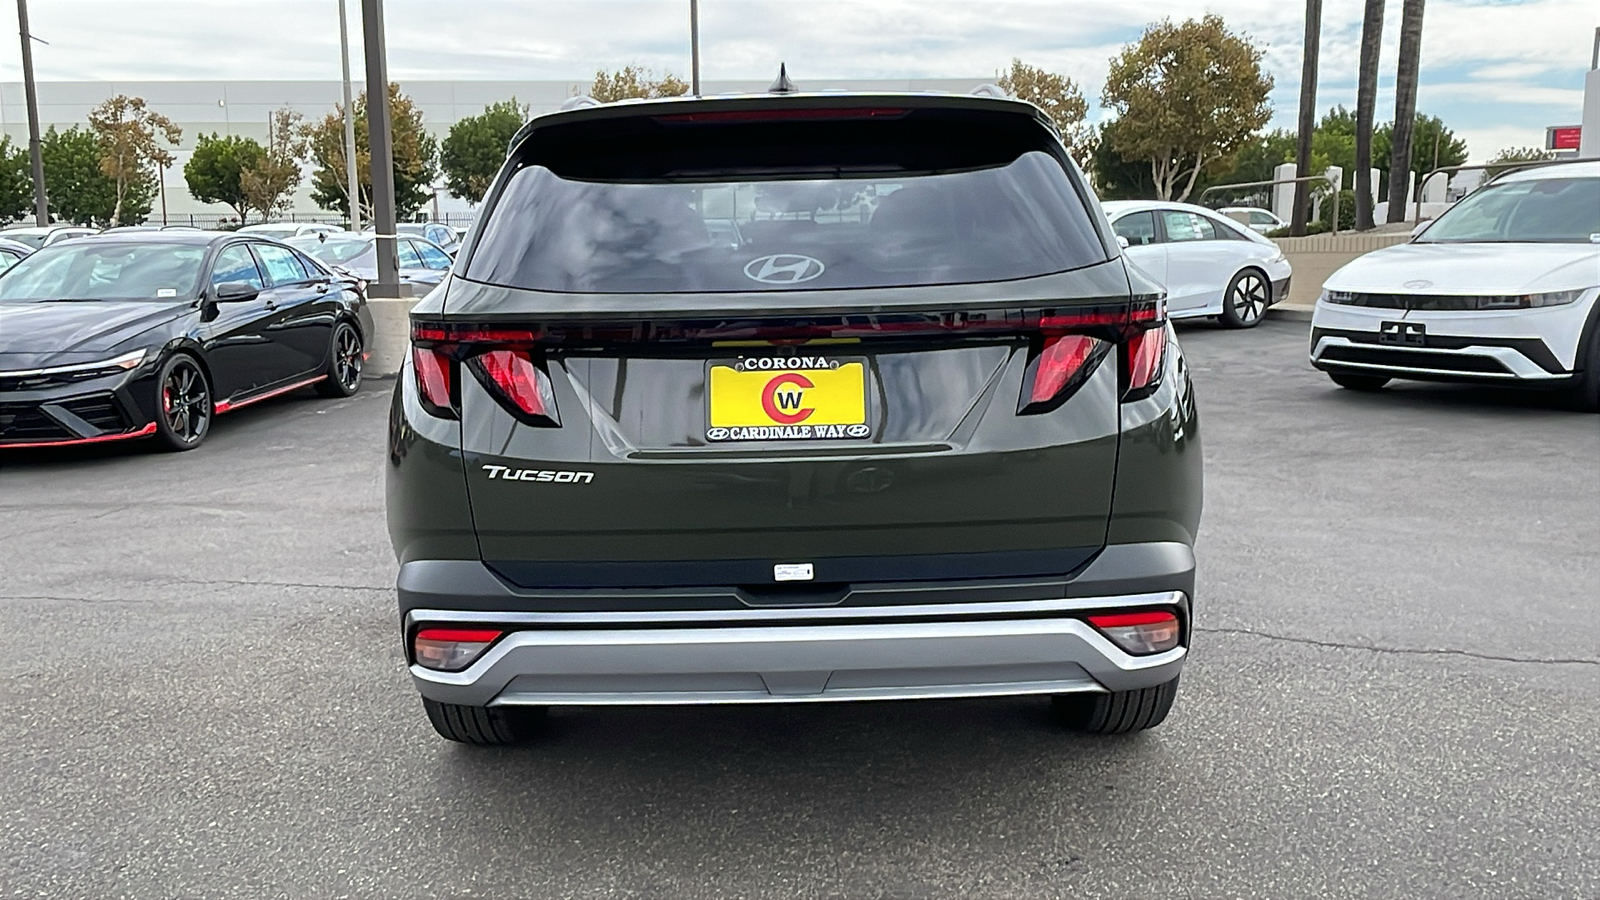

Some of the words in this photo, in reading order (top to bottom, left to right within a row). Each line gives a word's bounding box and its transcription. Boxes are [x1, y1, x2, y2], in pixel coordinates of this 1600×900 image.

[744, 356, 829, 370] CORONA
[730, 426, 811, 440] CARDINALE
[814, 425, 847, 438] WAY
